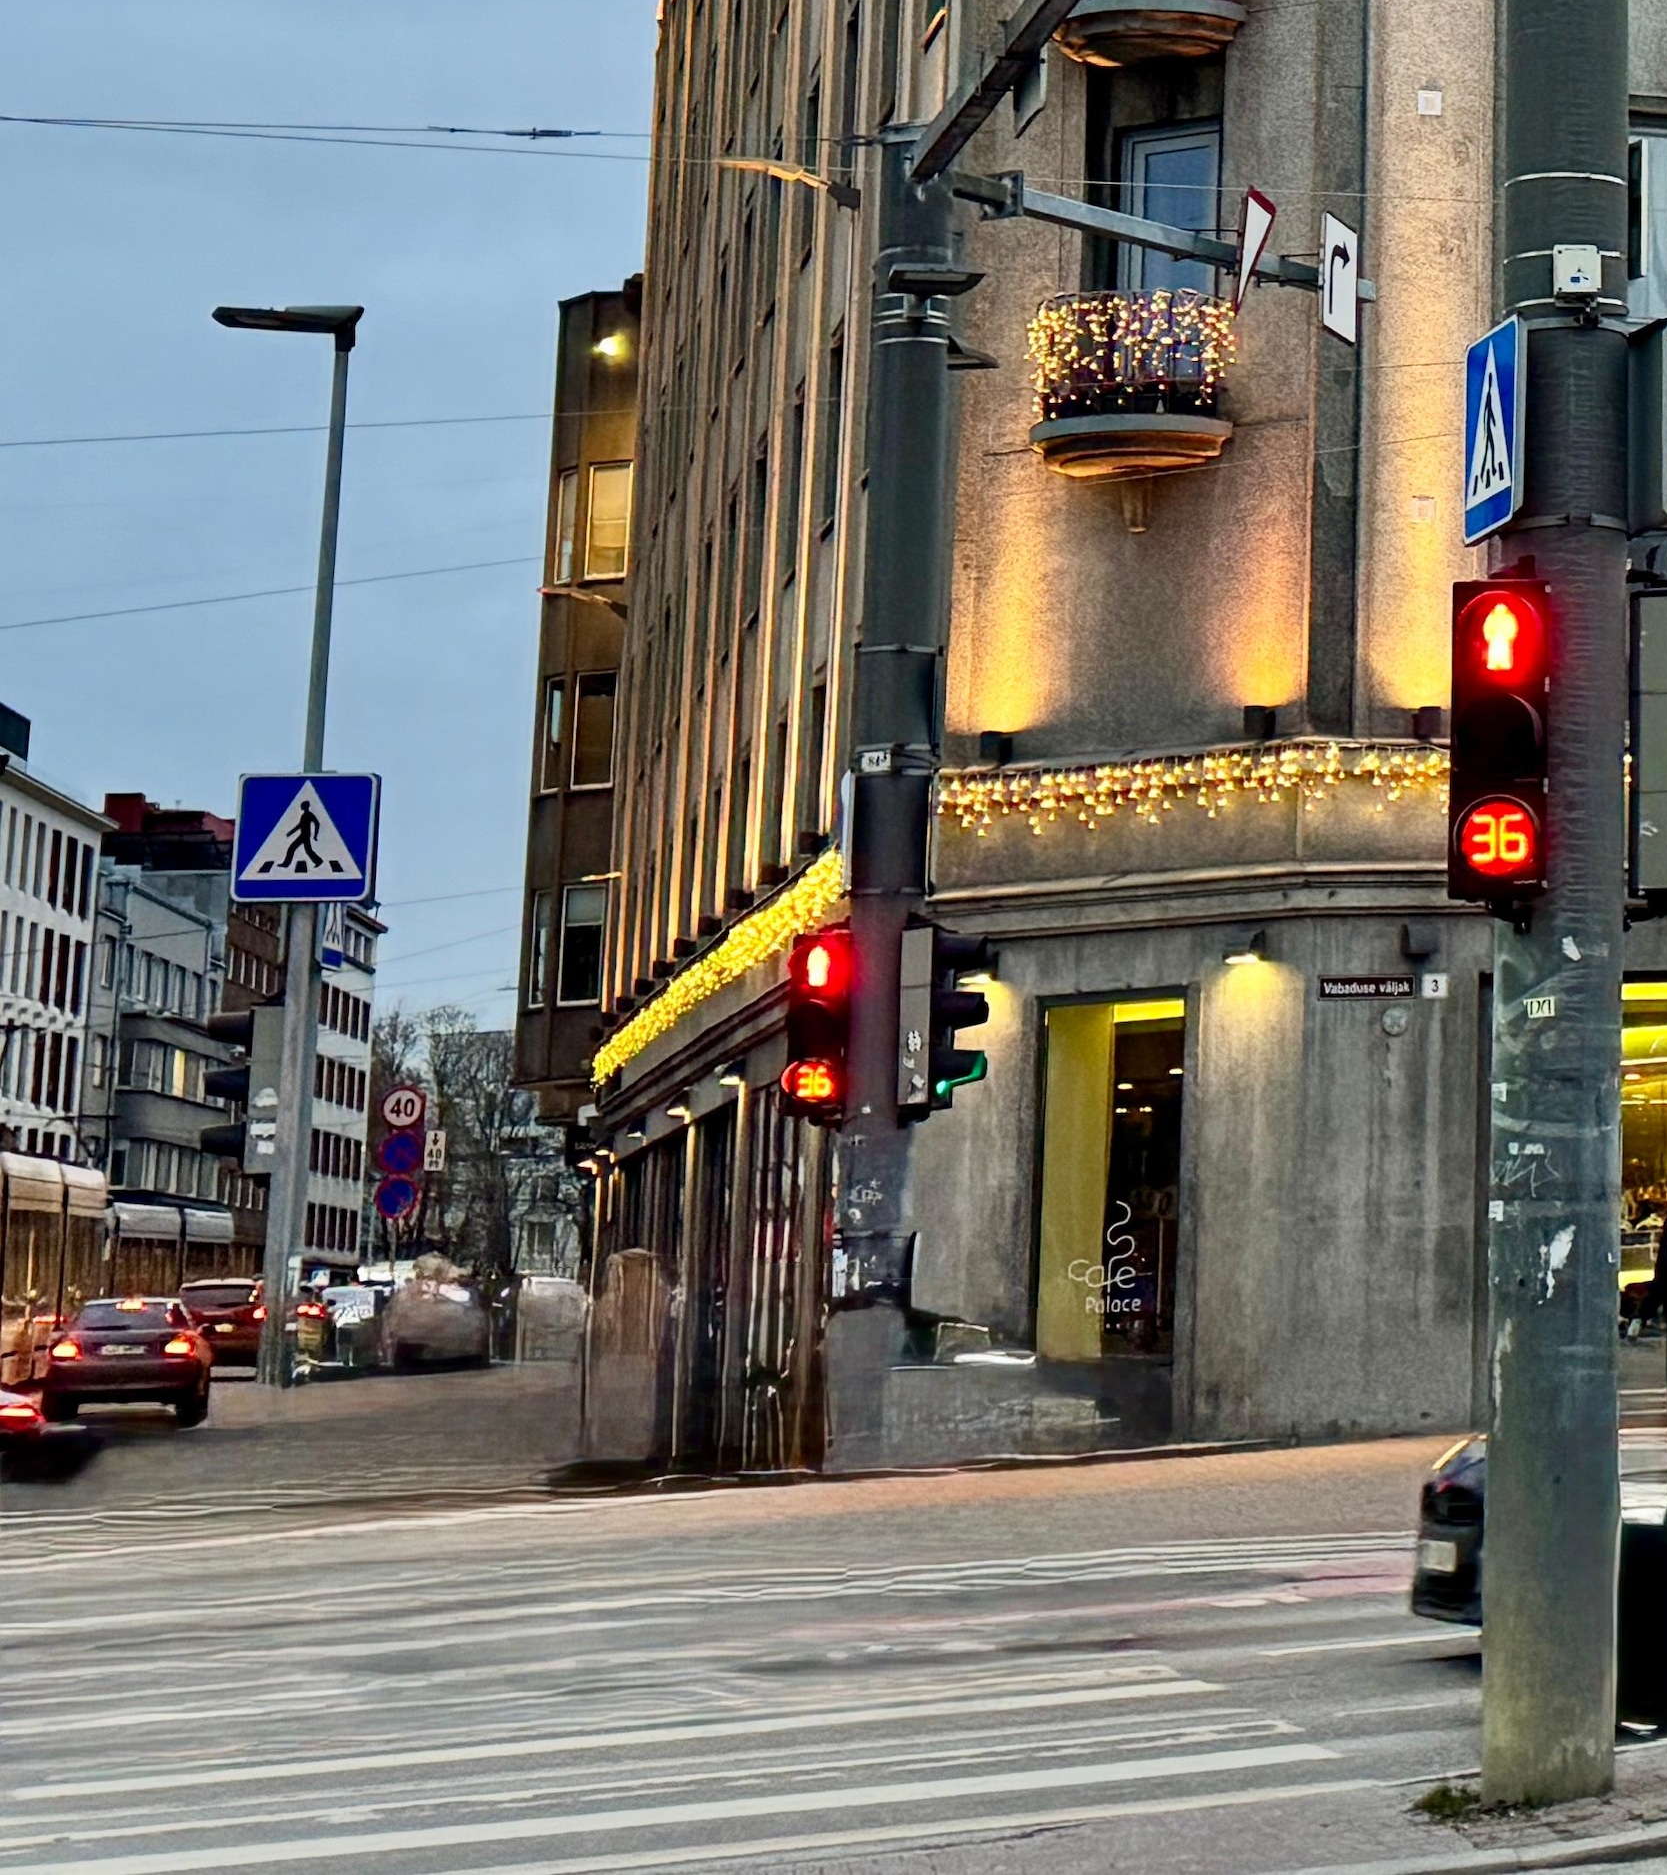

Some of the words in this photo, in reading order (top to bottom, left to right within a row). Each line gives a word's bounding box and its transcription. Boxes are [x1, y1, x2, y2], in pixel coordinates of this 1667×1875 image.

[1472, 812, 1529, 863] 36
[1323, 982, 1377, 995] Vabaduse
[1379, 981, 1411, 996] väljak
[1431, 979, 1439, 993] 3
[796, 1065, 833, 1098] 36
[390, 1097, 415, 1118] 40
[427, 1148, 442, 1159] 40
[1085, 1295, 1142, 1314] Palace
